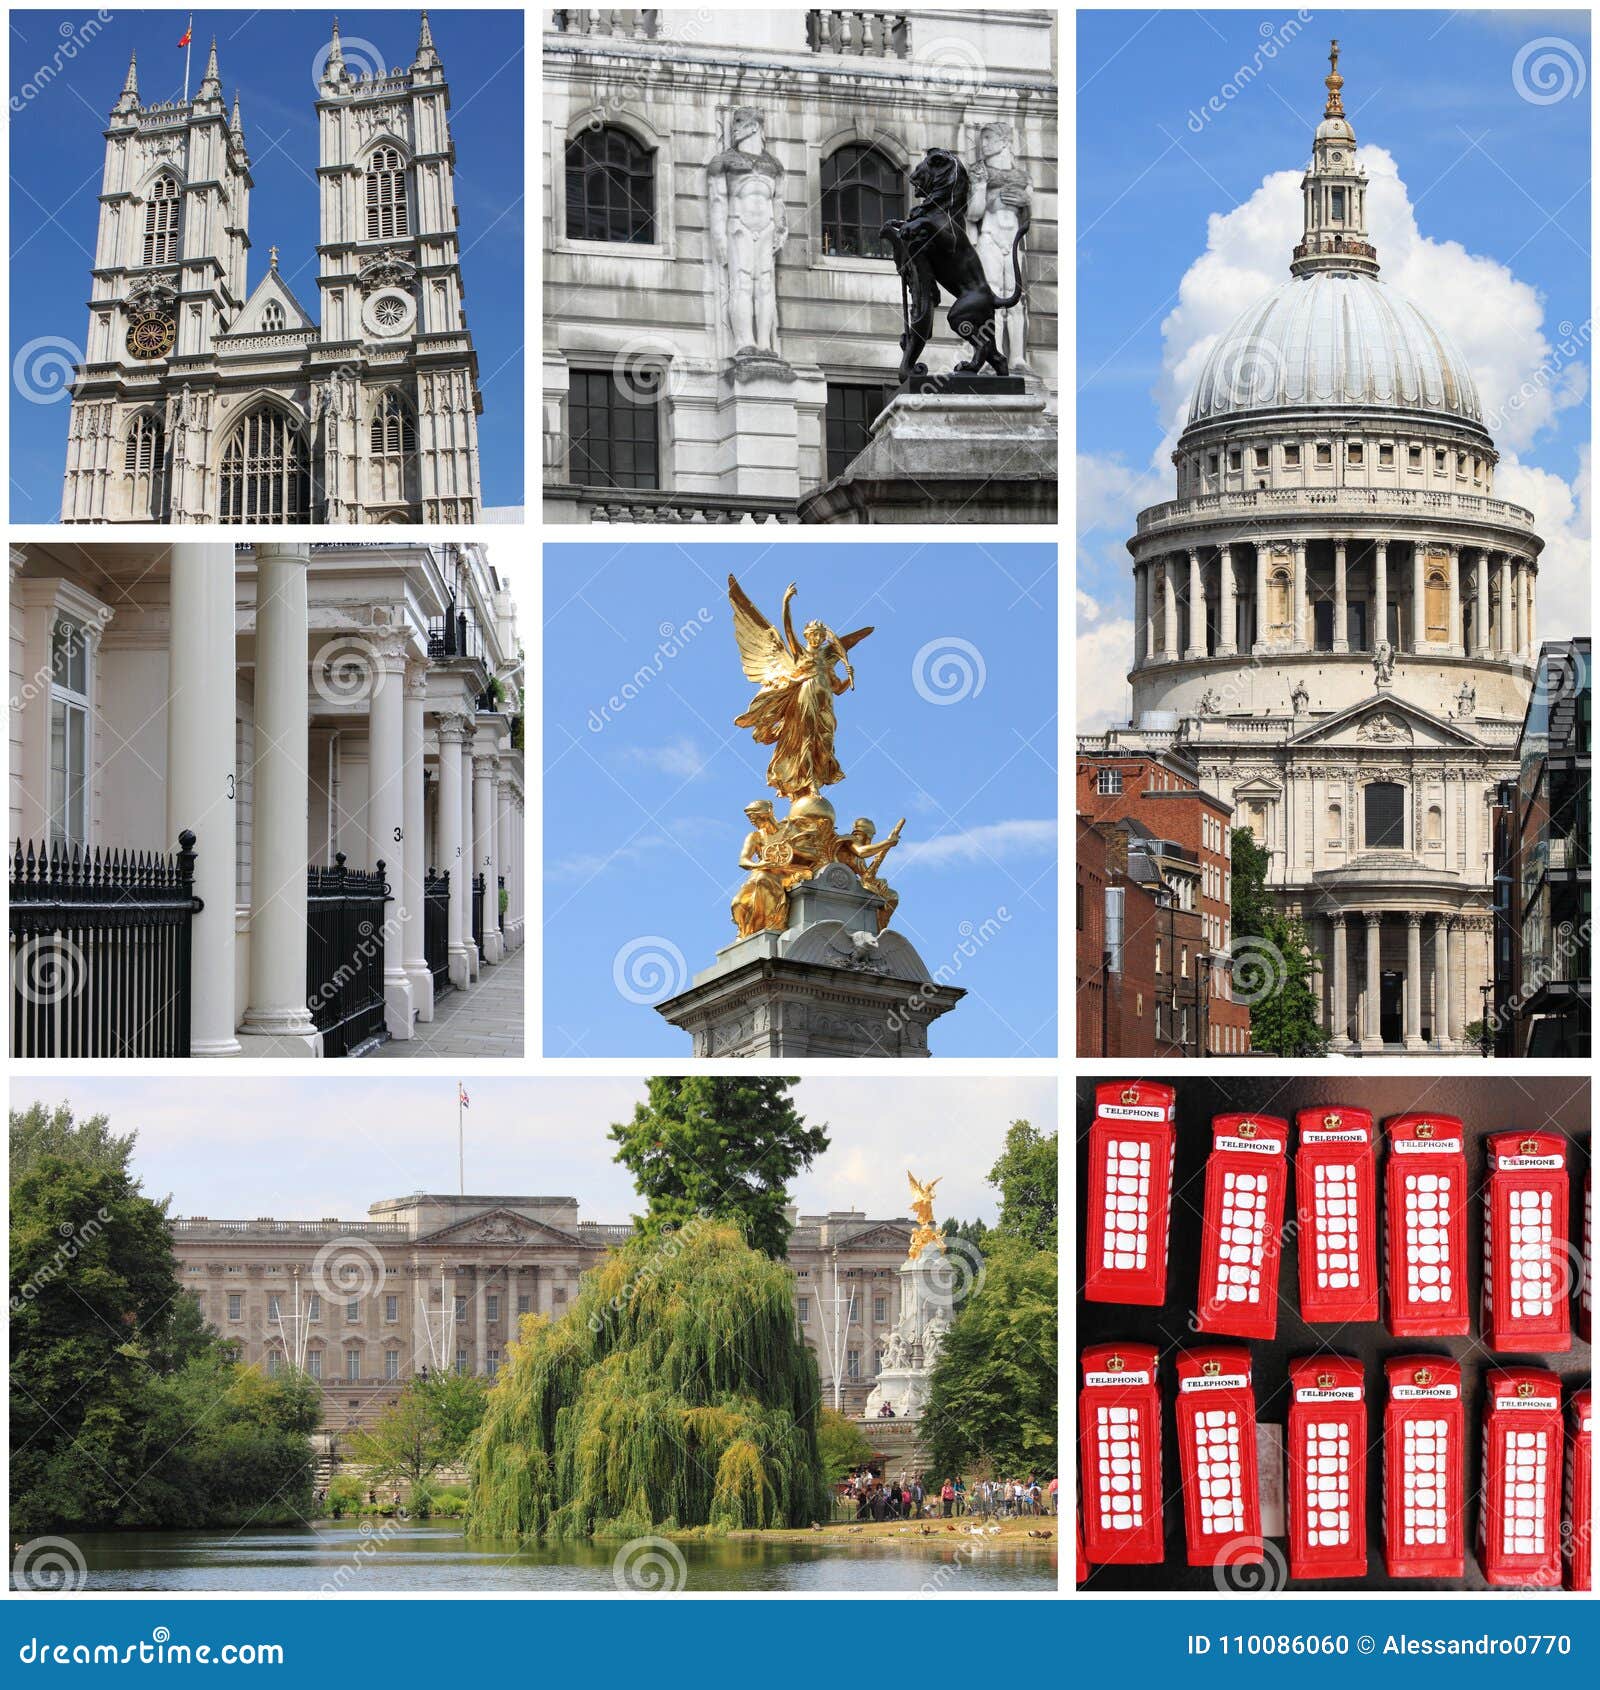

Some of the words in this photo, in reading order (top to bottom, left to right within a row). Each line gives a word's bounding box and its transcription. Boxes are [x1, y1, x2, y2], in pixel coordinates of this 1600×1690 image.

[1105, 1107, 1159, 1118] TELEPHONE
[1309, 1134, 1362, 1142] TELEPHONE
[1221, 1140, 1275, 1152] TELEPHONE
[1401, 1140, 1454, 1148] TELEPHONE
[1090, 1376, 1143, 1384] TELEPHONE
[1187, 1379, 1240, 1388] TELEPHONE
[1302, 1389, 1354, 1398] TELEPHONE
[1400, 1388, 1451, 1396] TELEPHONE
[1501, 1400, 1552, 1408] TELEPHONE
